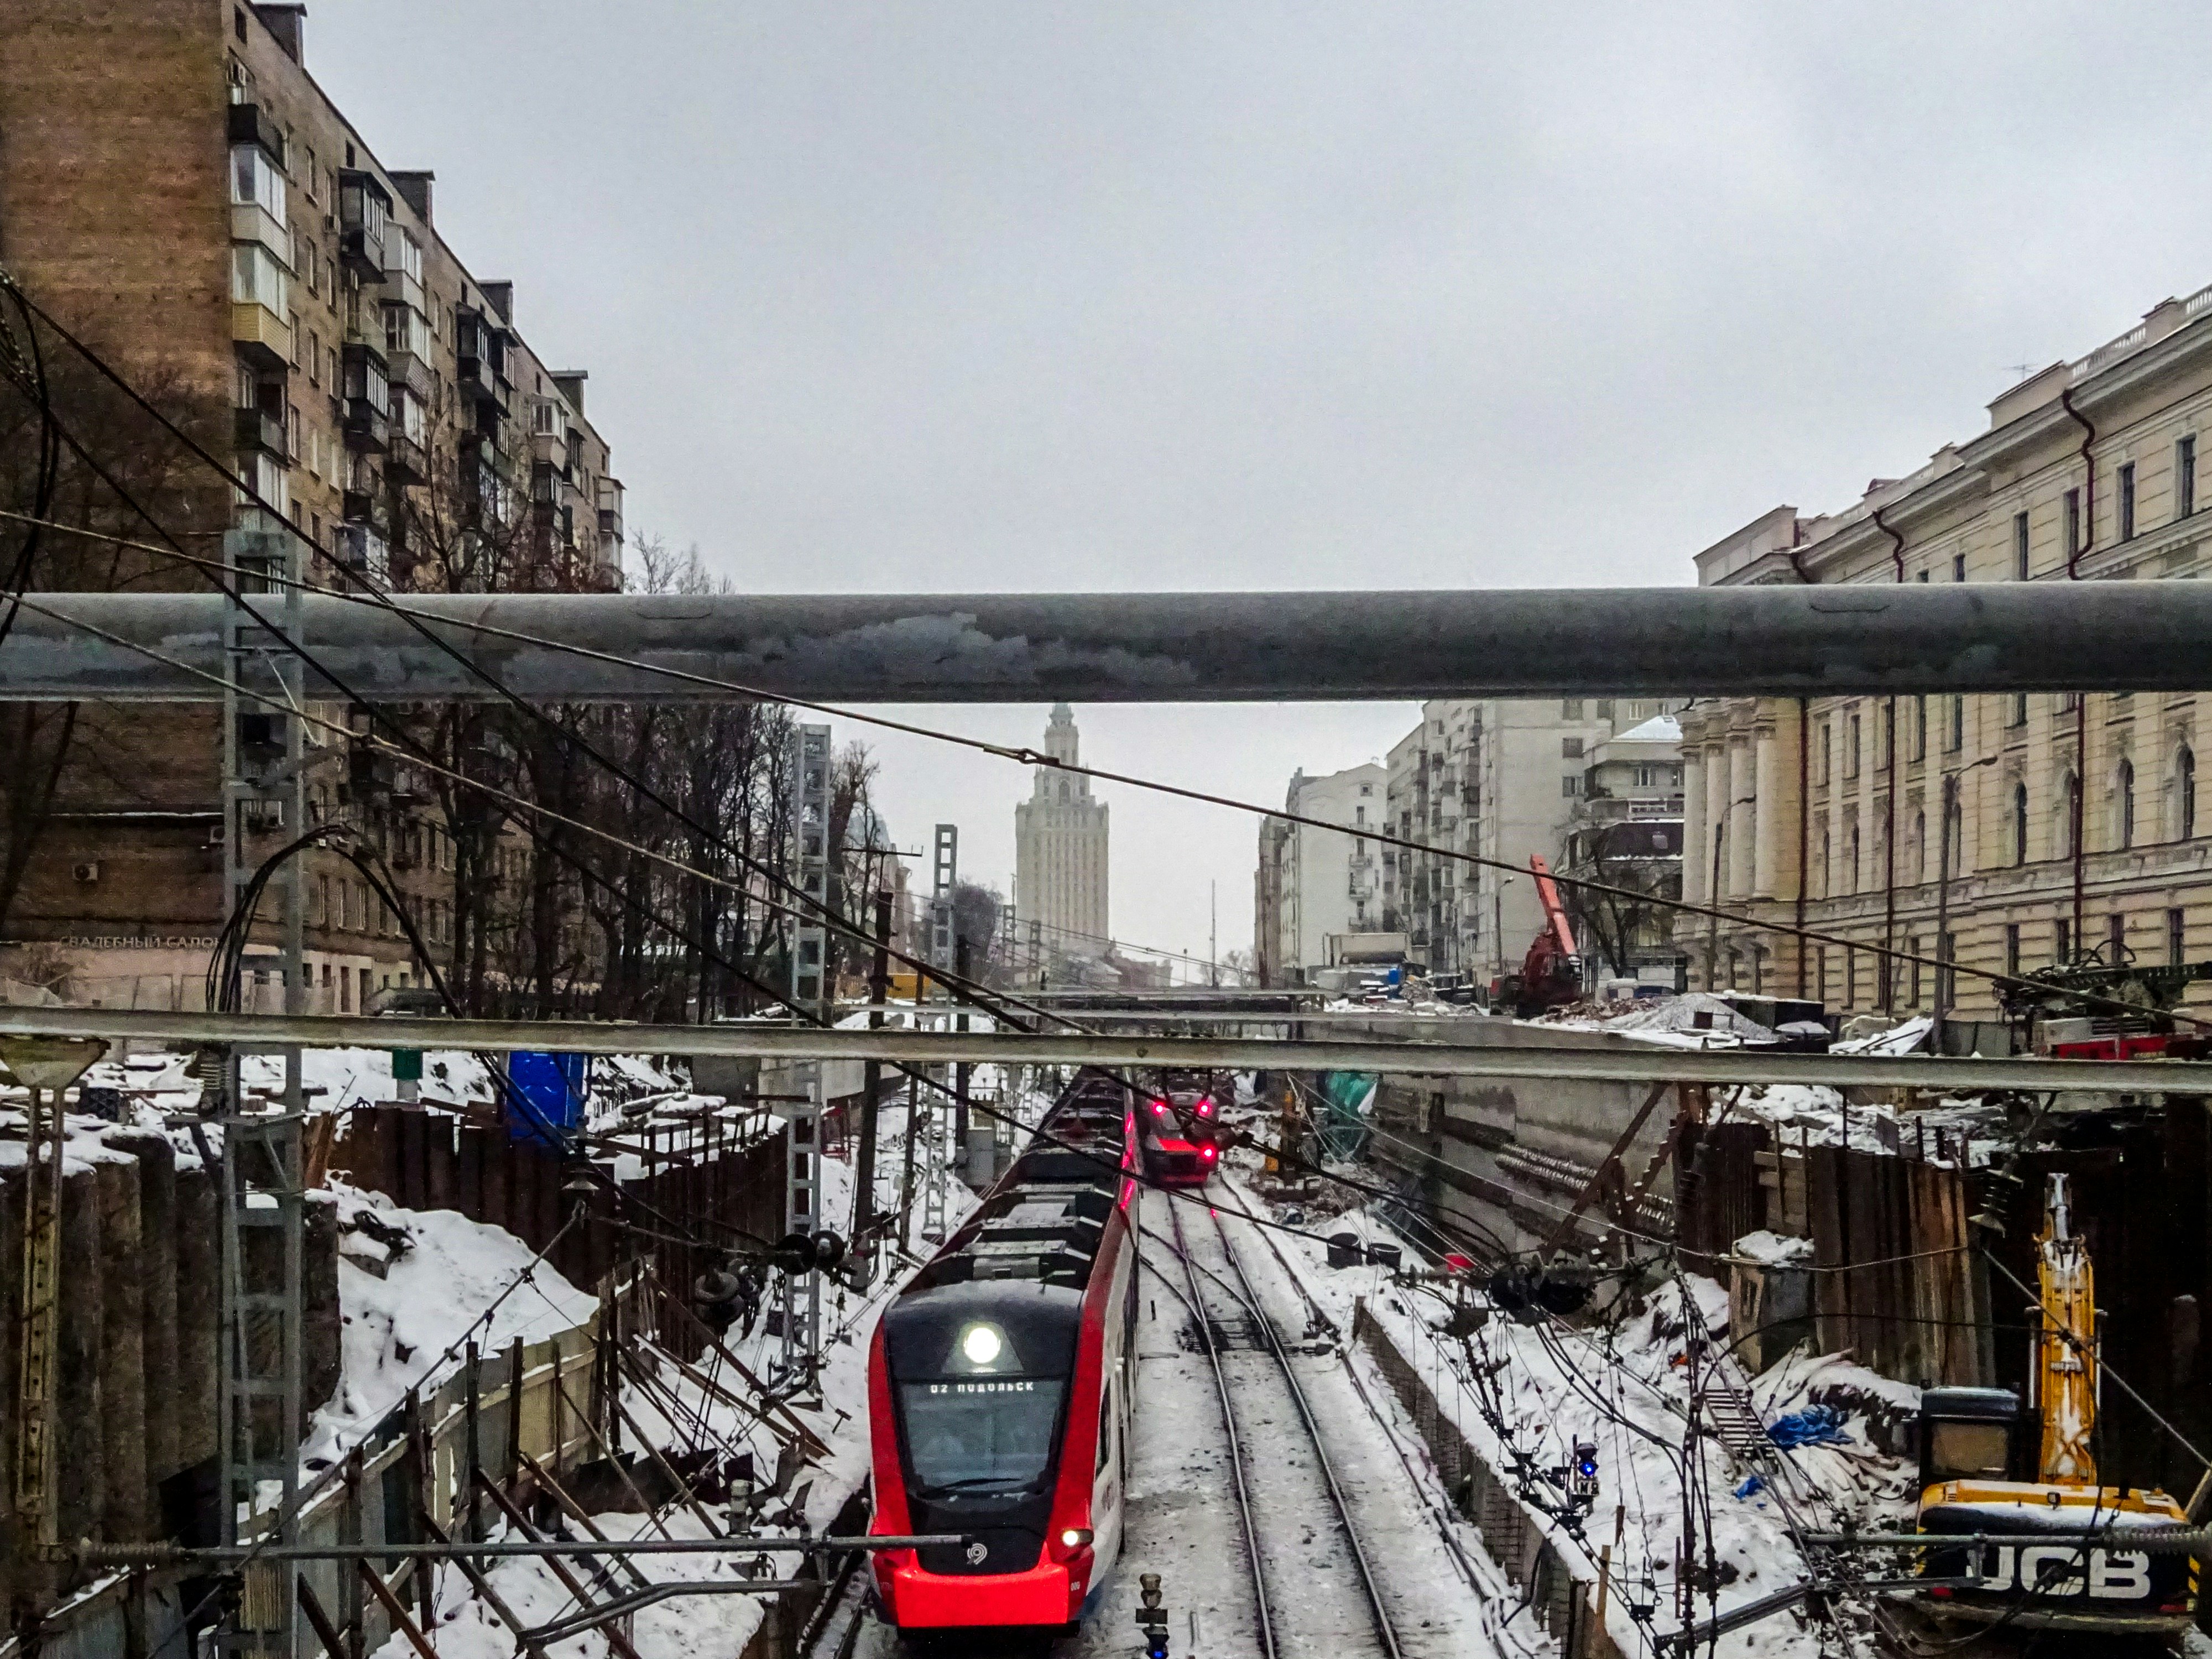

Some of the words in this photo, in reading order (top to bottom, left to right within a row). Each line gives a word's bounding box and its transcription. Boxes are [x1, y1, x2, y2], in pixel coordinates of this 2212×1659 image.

[59, 935, 160, 949] СВАДЕБНЫЙ
[957, 1381, 1034, 1393] ПОДОЛЬСК
[1966, 1546, 2151, 1599] JCB
